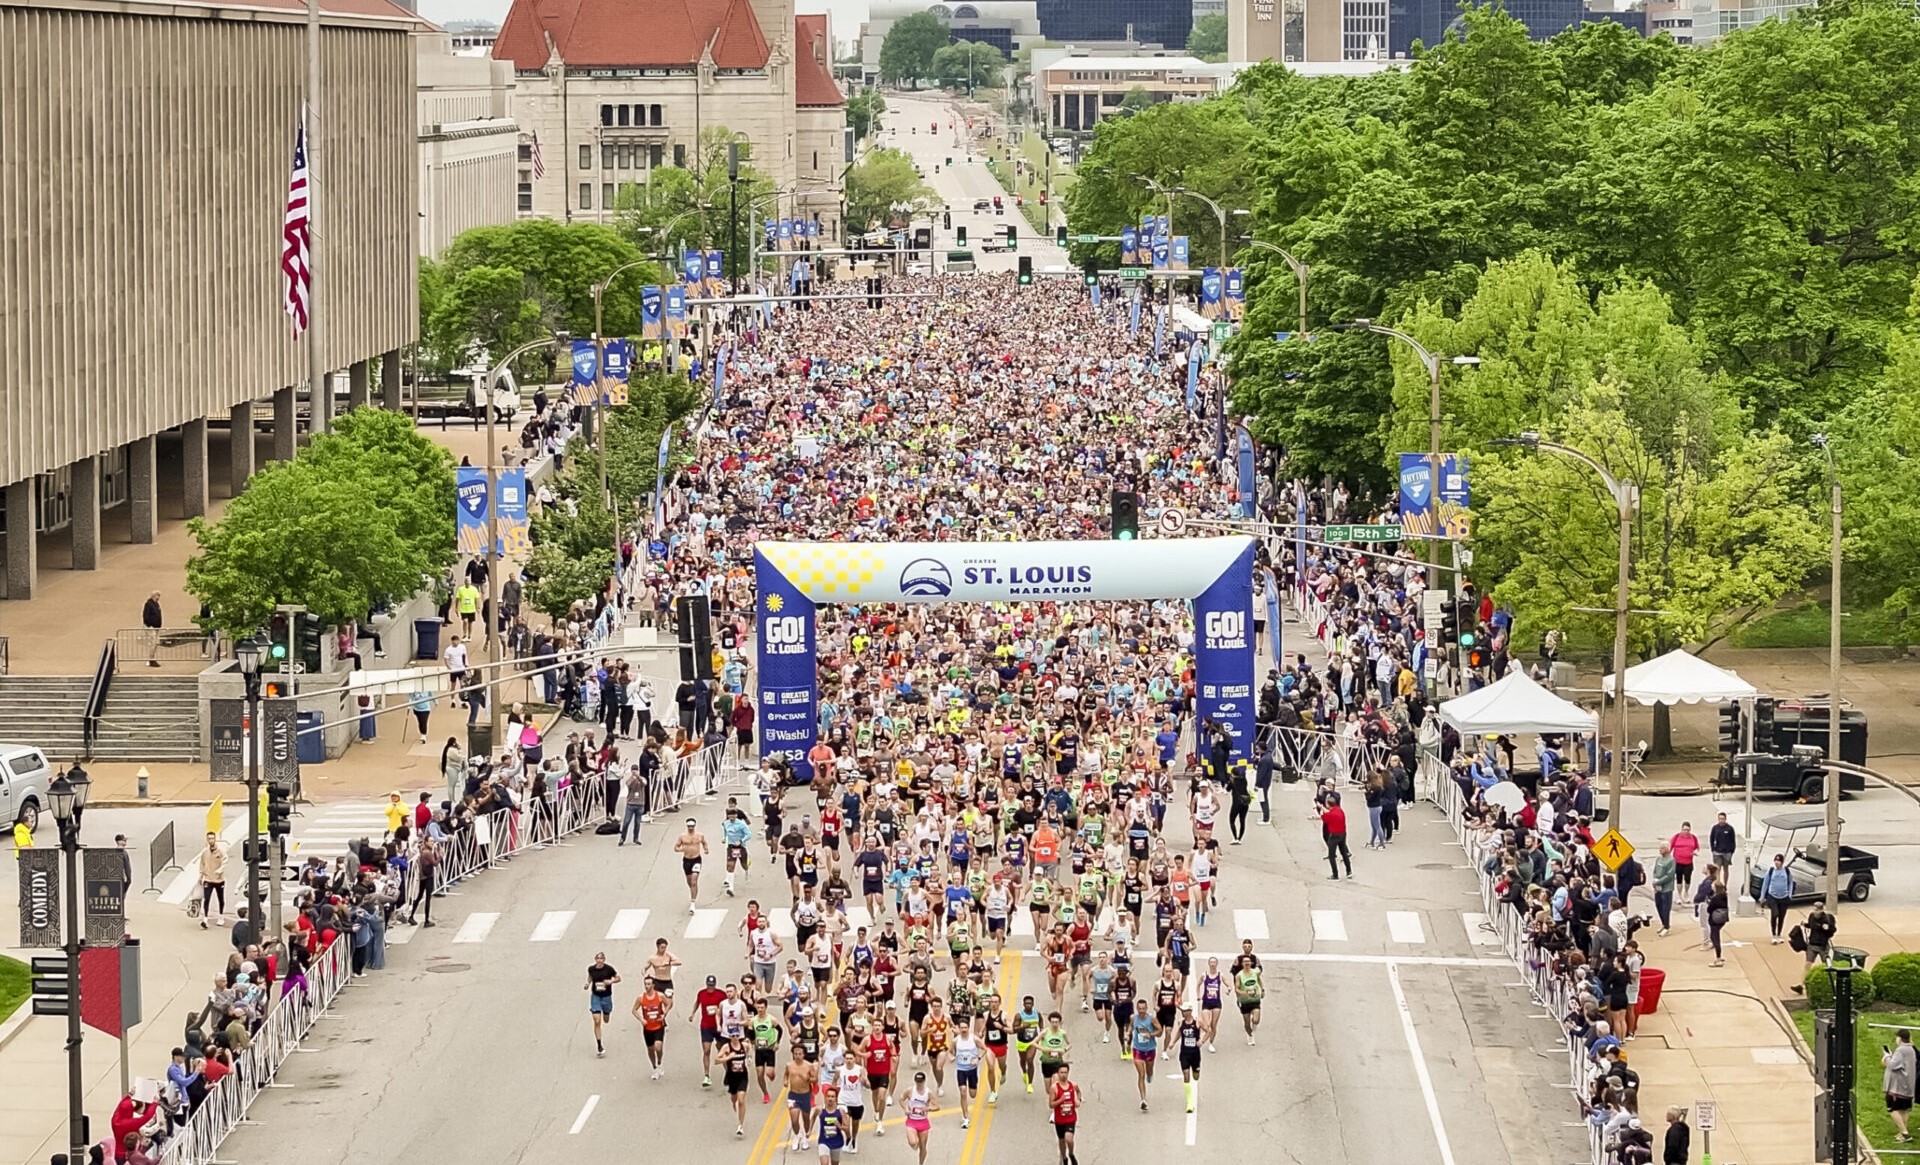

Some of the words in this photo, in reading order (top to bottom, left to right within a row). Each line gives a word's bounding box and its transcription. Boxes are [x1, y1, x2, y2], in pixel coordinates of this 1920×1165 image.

[1252, 3, 1274, 12] TREE
[1257, 12, 1272, 20] INN
[1402, 469, 1430, 486] RHYTHM
[458, 482, 487, 499] RHYTHM
[1353, 527, 1380, 539] 15th
[1385, 527, 1399, 538] St
[964, 567, 1003, 585] ST.
[1009, 565, 1092, 584] LOUIS
[1009, 586, 1092, 594] MARATHON
[765, 616, 805, 643] GO!
[1205, 610, 1246, 638] GO!
[273, 720, 288, 761] GALAS
[775, 728, 809, 741] WashU
[214, 739, 241, 747] STIFEL
[31, 869, 48, 929] COMEDY
[88, 896, 121, 905] STIFEL
